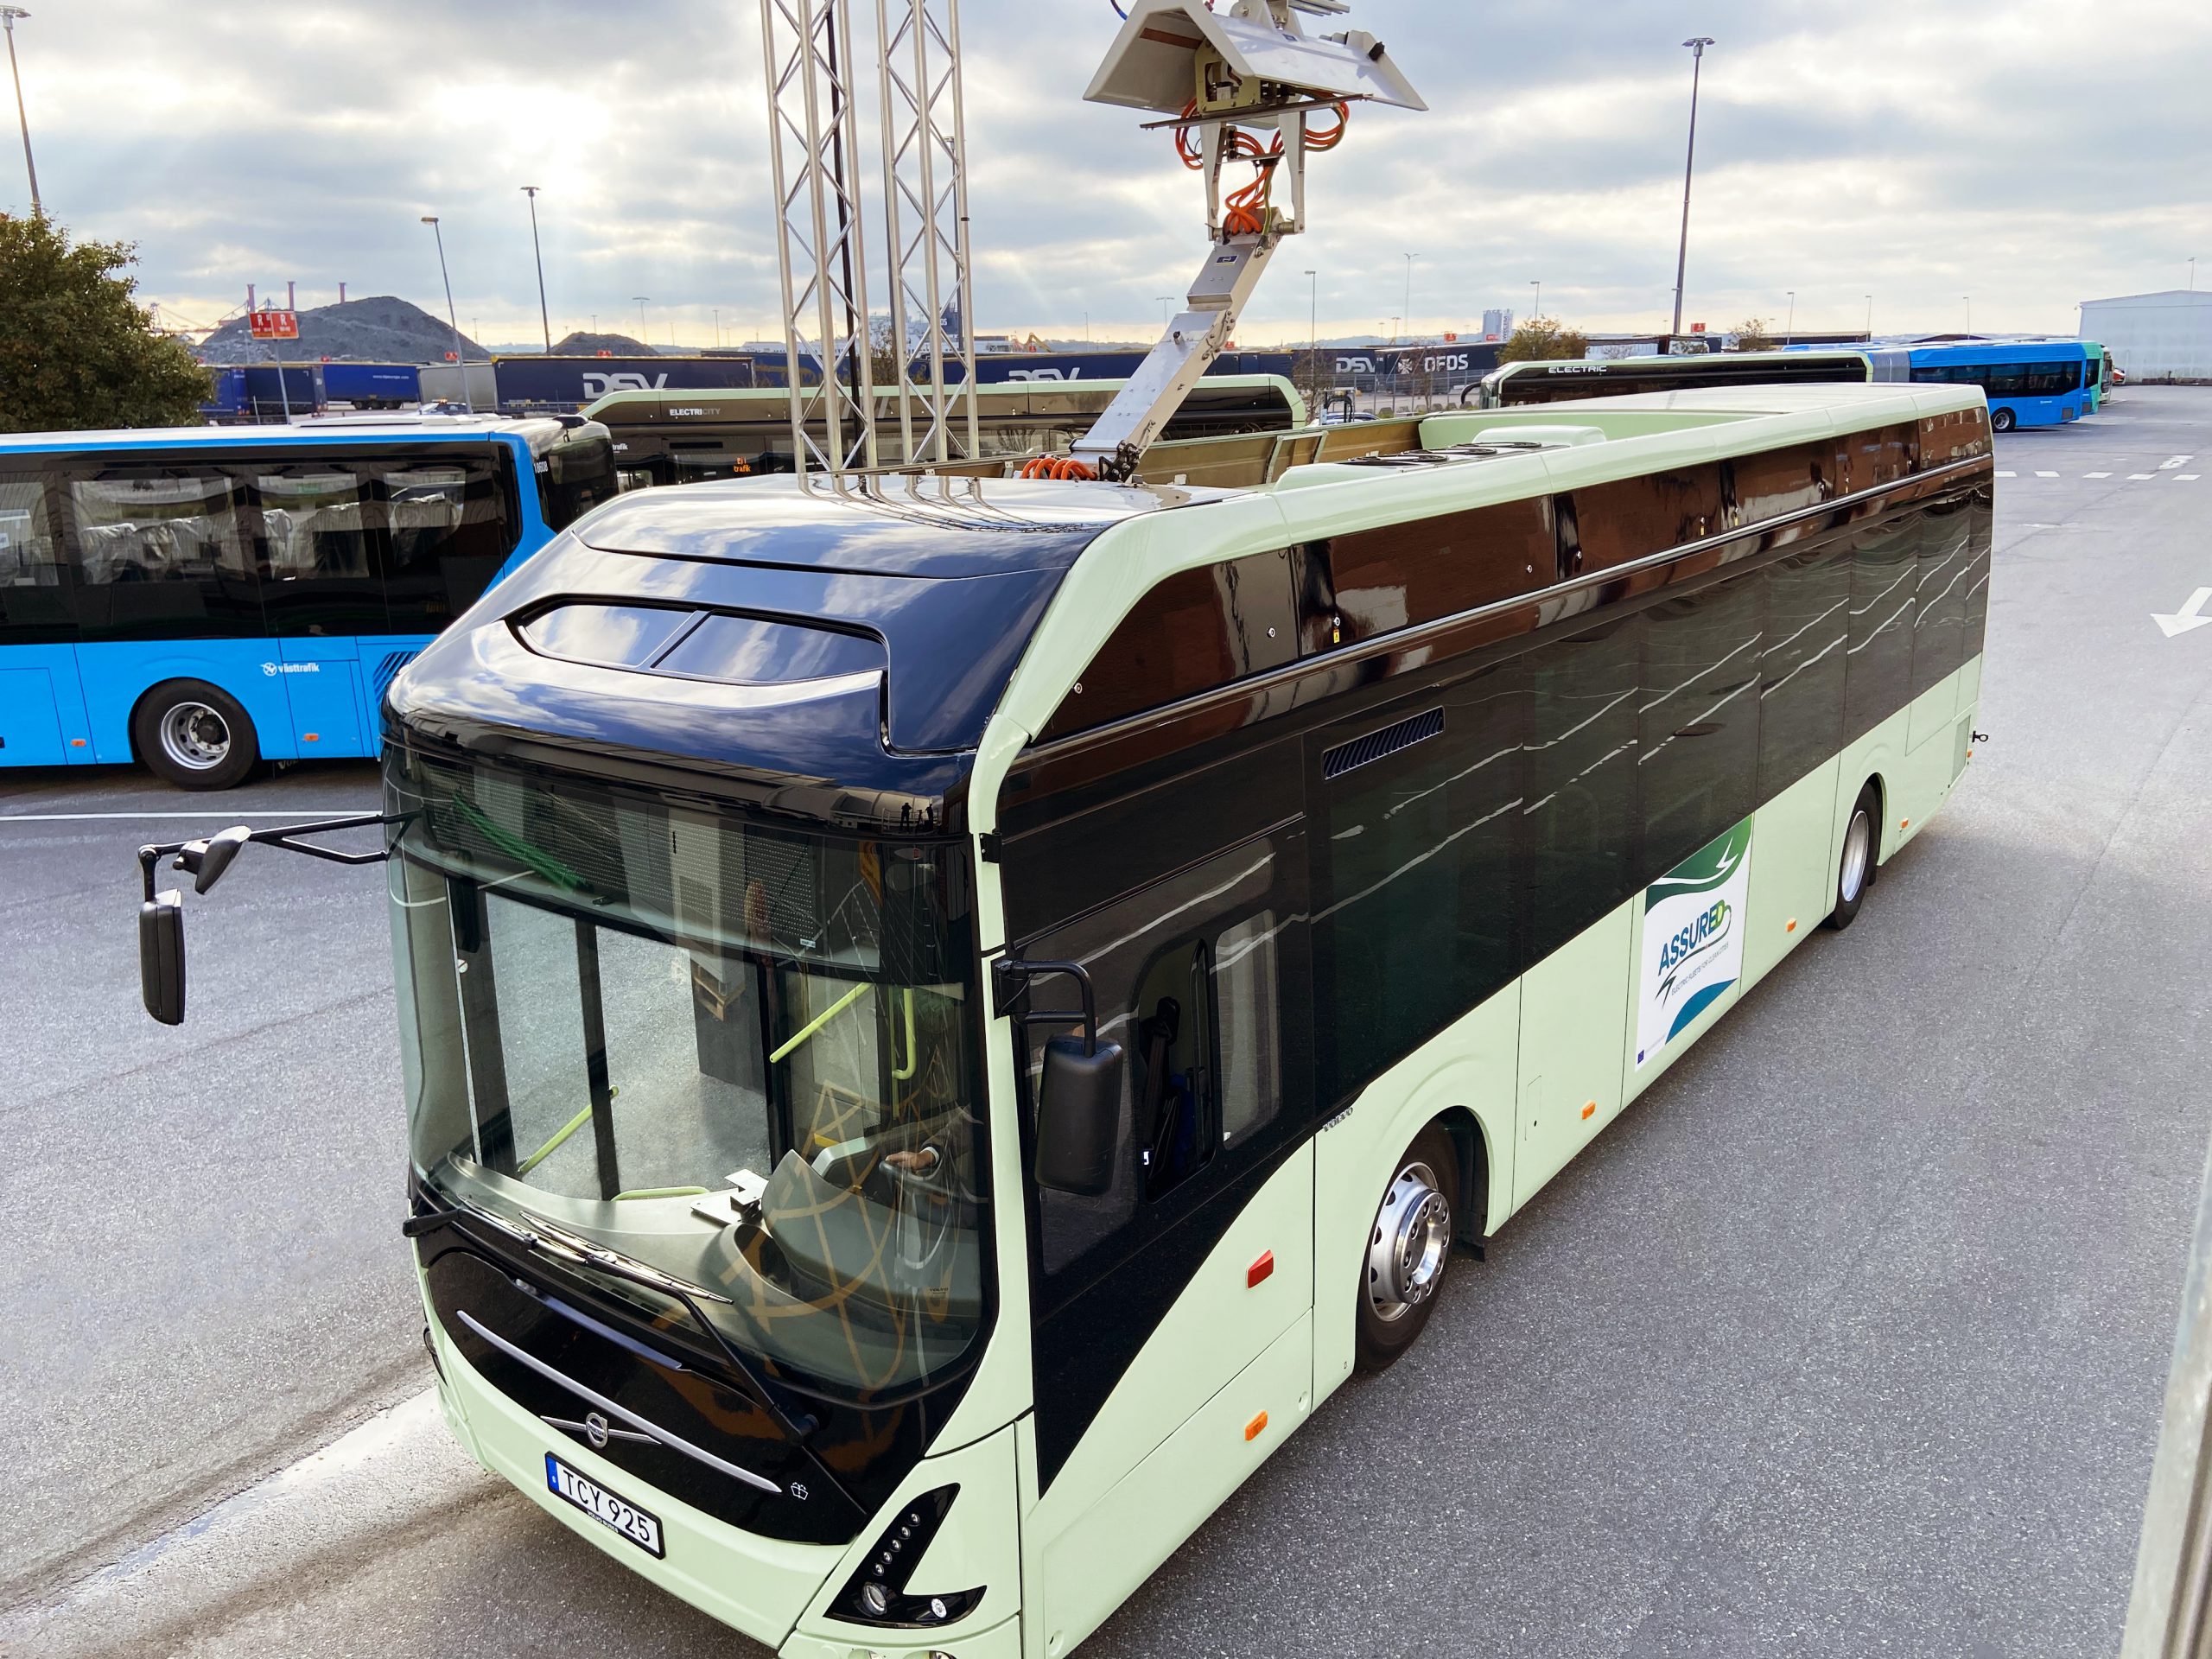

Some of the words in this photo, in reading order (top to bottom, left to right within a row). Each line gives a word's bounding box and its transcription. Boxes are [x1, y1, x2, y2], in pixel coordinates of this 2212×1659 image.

[257, 314, 264, 326] R
[280, 314, 287, 326] R
[1336, 357, 1376, 373] DSV
[1425, 353, 1469, 372] DFDS
[1548, 365, 1607, 374] ELECTRIC
[582, 372, 669, 399] DSV
[669, 408, 721, 416] ELECTRICITY
[733, 464, 752, 473] trafik
[1658, 899, 1726, 976] ASSURED
[1322, 1107, 1353, 1132] VOLVO
[563, 1469, 601, 1512] TCY
[607, 1498, 651, 1542] 925
